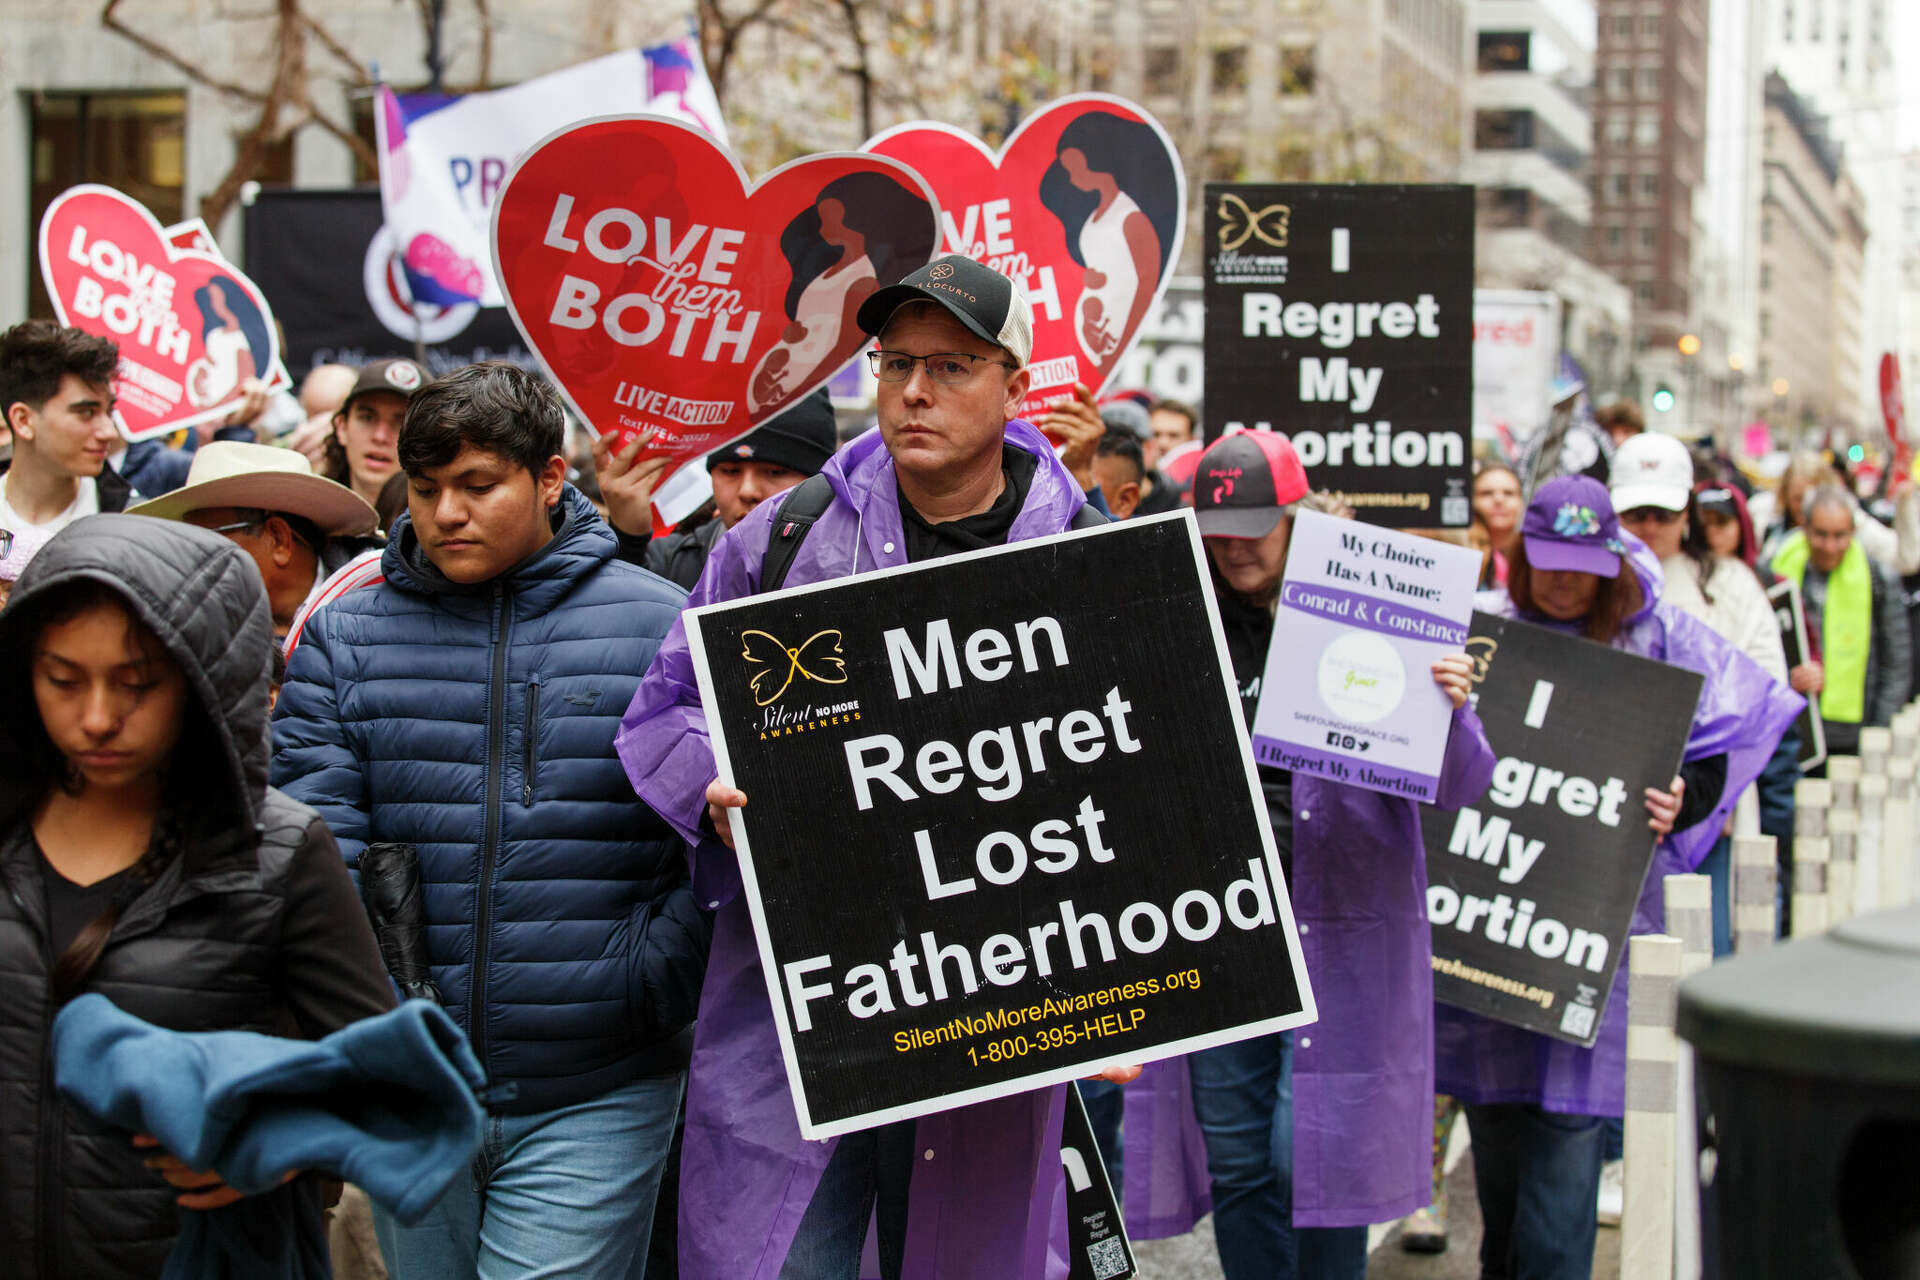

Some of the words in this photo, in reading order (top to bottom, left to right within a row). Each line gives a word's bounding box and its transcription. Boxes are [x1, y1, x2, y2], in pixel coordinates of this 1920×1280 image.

[544, 193, 746, 285] LOVE
[941, 198, 1015, 256] VE
[1331, 227, 1350, 273] I
[68, 225, 176, 307] LOVE
[627, 256, 744, 316] them
[926, 281, 977, 303] LOCURTO
[72, 275, 192, 367] BOTH
[549, 274, 762, 364] BOTH
[1242, 292, 1440, 349] Regret
[613, 381, 668, 415] LIVE
[666, 399, 733, 424] ACTION
[1029, 359, 1077, 387] CTION
[1299, 356, 1384, 414] My
[618, 414, 643, 431] Text
[1223, 420, 1465, 467] ortion
[1325, 559, 1362, 583] Has
[1364, 570, 1378, 587] A
[1383, 573, 1442, 602] Name:
[1341, 532, 1365, 558] My
[1370, 541, 1436, 570] Choice
[1284, 584, 1351, 616] Conrad
[1353, 601, 1369, 623] &
[1374, 606, 1468, 644] Constance
[883, 616, 1070, 700] Men
[753, 704, 812, 731] Silent
[815, 706, 831, 718] NO
[831, 700, 860, 714] MORE
[760, 712, 861, 741] AWARENESS
[1524, 679, 1555, 730] I
[843, 685, 1142, 811] Regret
[1260, 744, 1267, 759] I
[1270, 746, 1324, 770] Regret
[1329, 759, 1350, 781] My
[1357, 768, 1428, 797] Abortion
[1489, 755, 1627, 827] gret
[913, 794, 1116, 901] Lost
[1448, 806, 1546, 885] My
[783, 858, 1276, 1033] Fatherhood
[1425, 884, 1610, 973] ortion
[893, 967, 1201, 1053] SilentNoMoreAwareness.org
[967, 1008, 1147, 1068] 1-800-395-HELP
